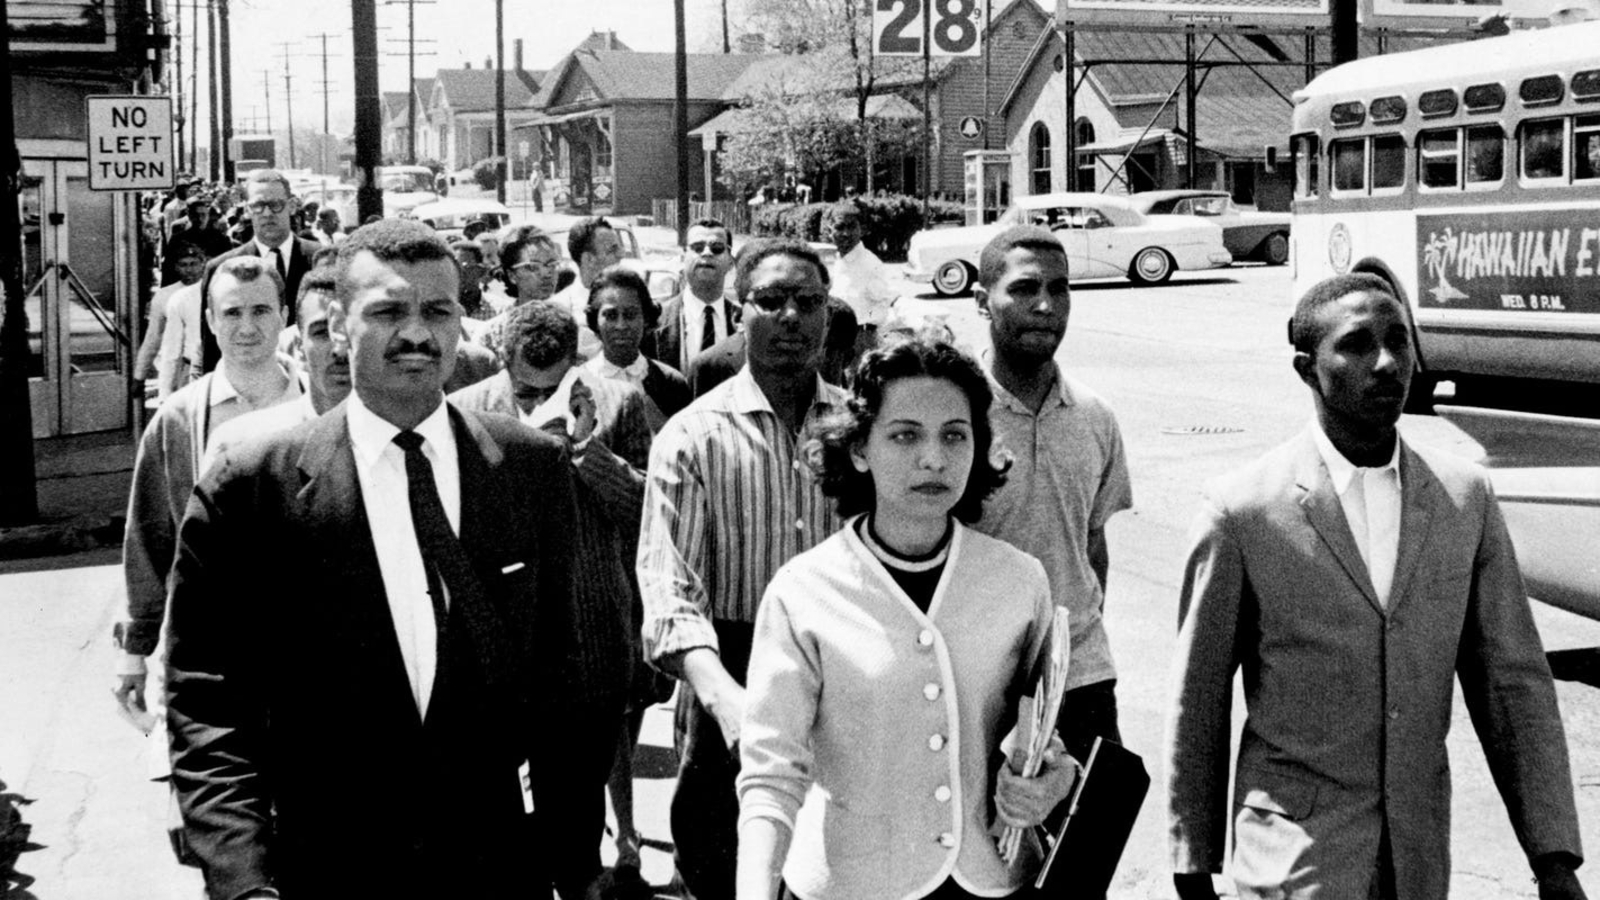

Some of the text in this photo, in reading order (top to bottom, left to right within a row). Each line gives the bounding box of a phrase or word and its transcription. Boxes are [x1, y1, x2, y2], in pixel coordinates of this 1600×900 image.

[877, 0, 977, 53] 28
[112, 106, 147, 129] NO
[100, 136, 162, 154] LEFT
[98, 161, 164, 179] TURN
[1457, 227, 1600, 280] HAWAIIAN E
[1530, 294, 1538, 309] 8
[1541, 295, 1566, 310] P.M.
